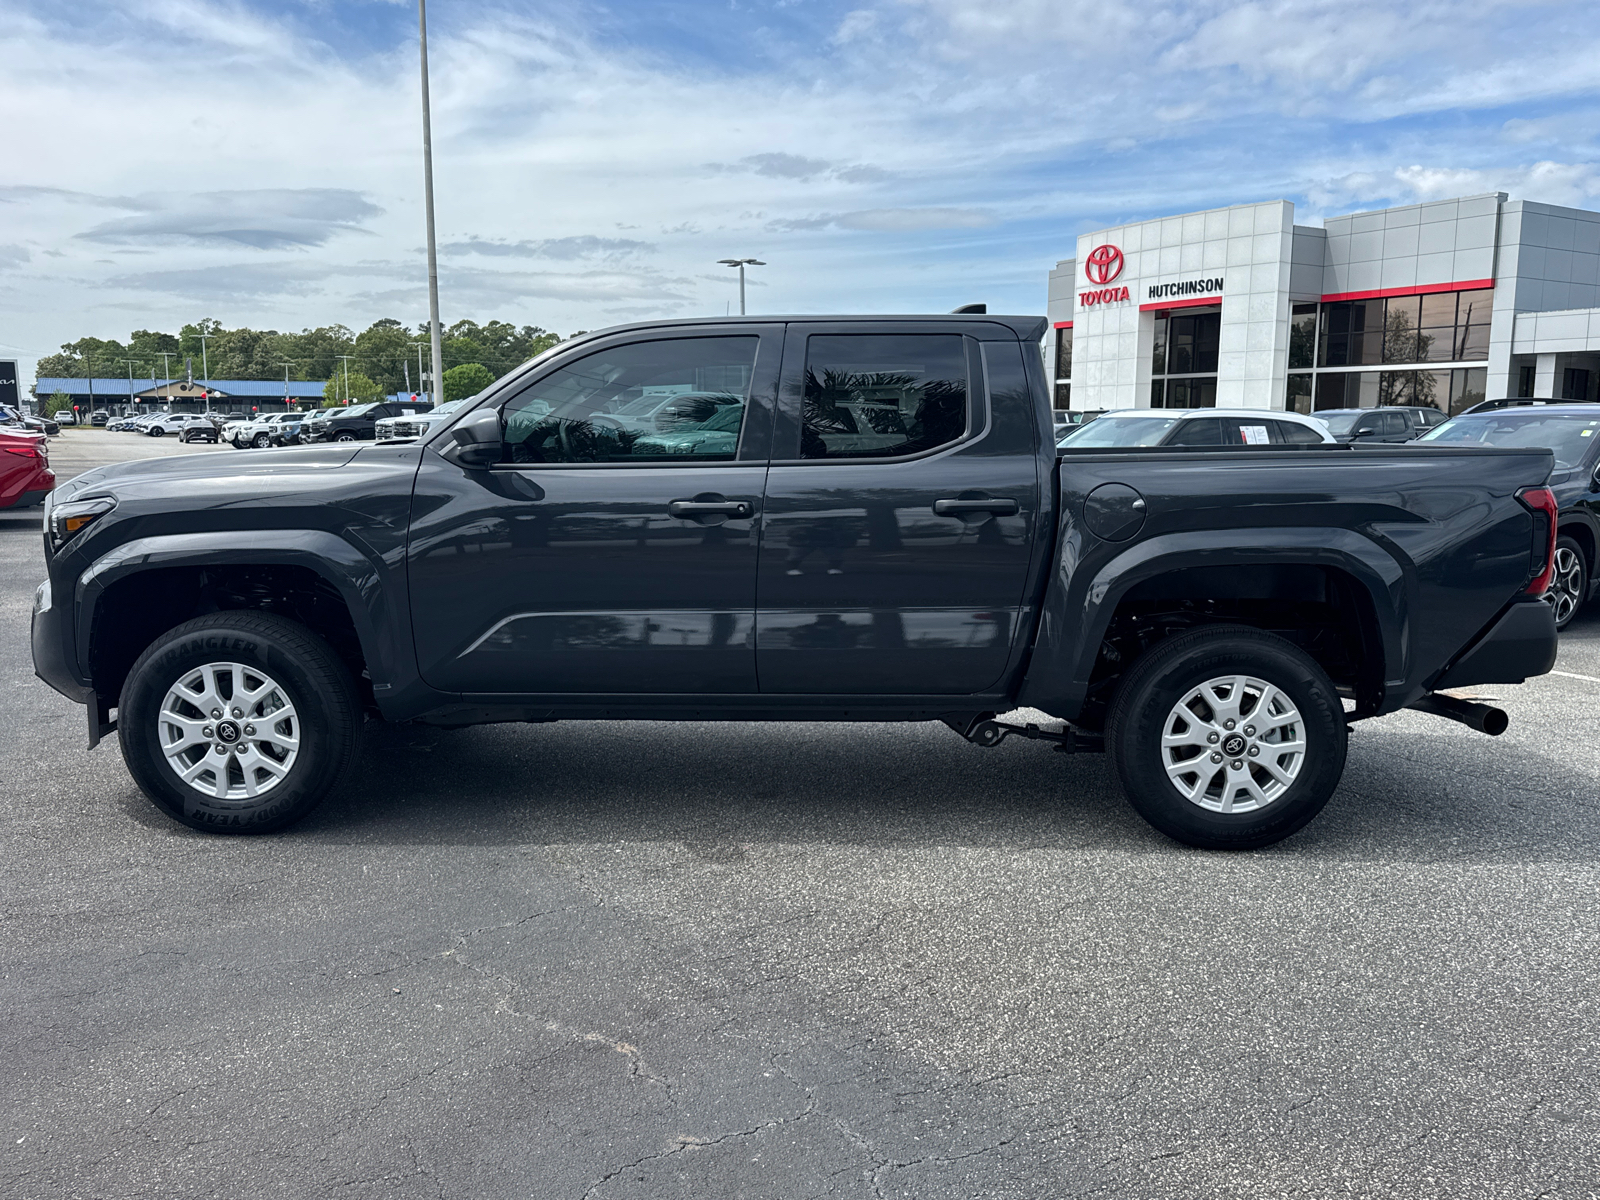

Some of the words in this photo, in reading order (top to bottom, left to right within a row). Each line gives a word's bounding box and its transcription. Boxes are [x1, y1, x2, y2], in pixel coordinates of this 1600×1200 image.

[1079, 286, 1130, 307] TOYOTA
[1148, 277, 1224, 298] HUTCHINSON
[150, 636, 258, 674] WRANGLER
[1189, 653, 1255, 671] TERRITORY
